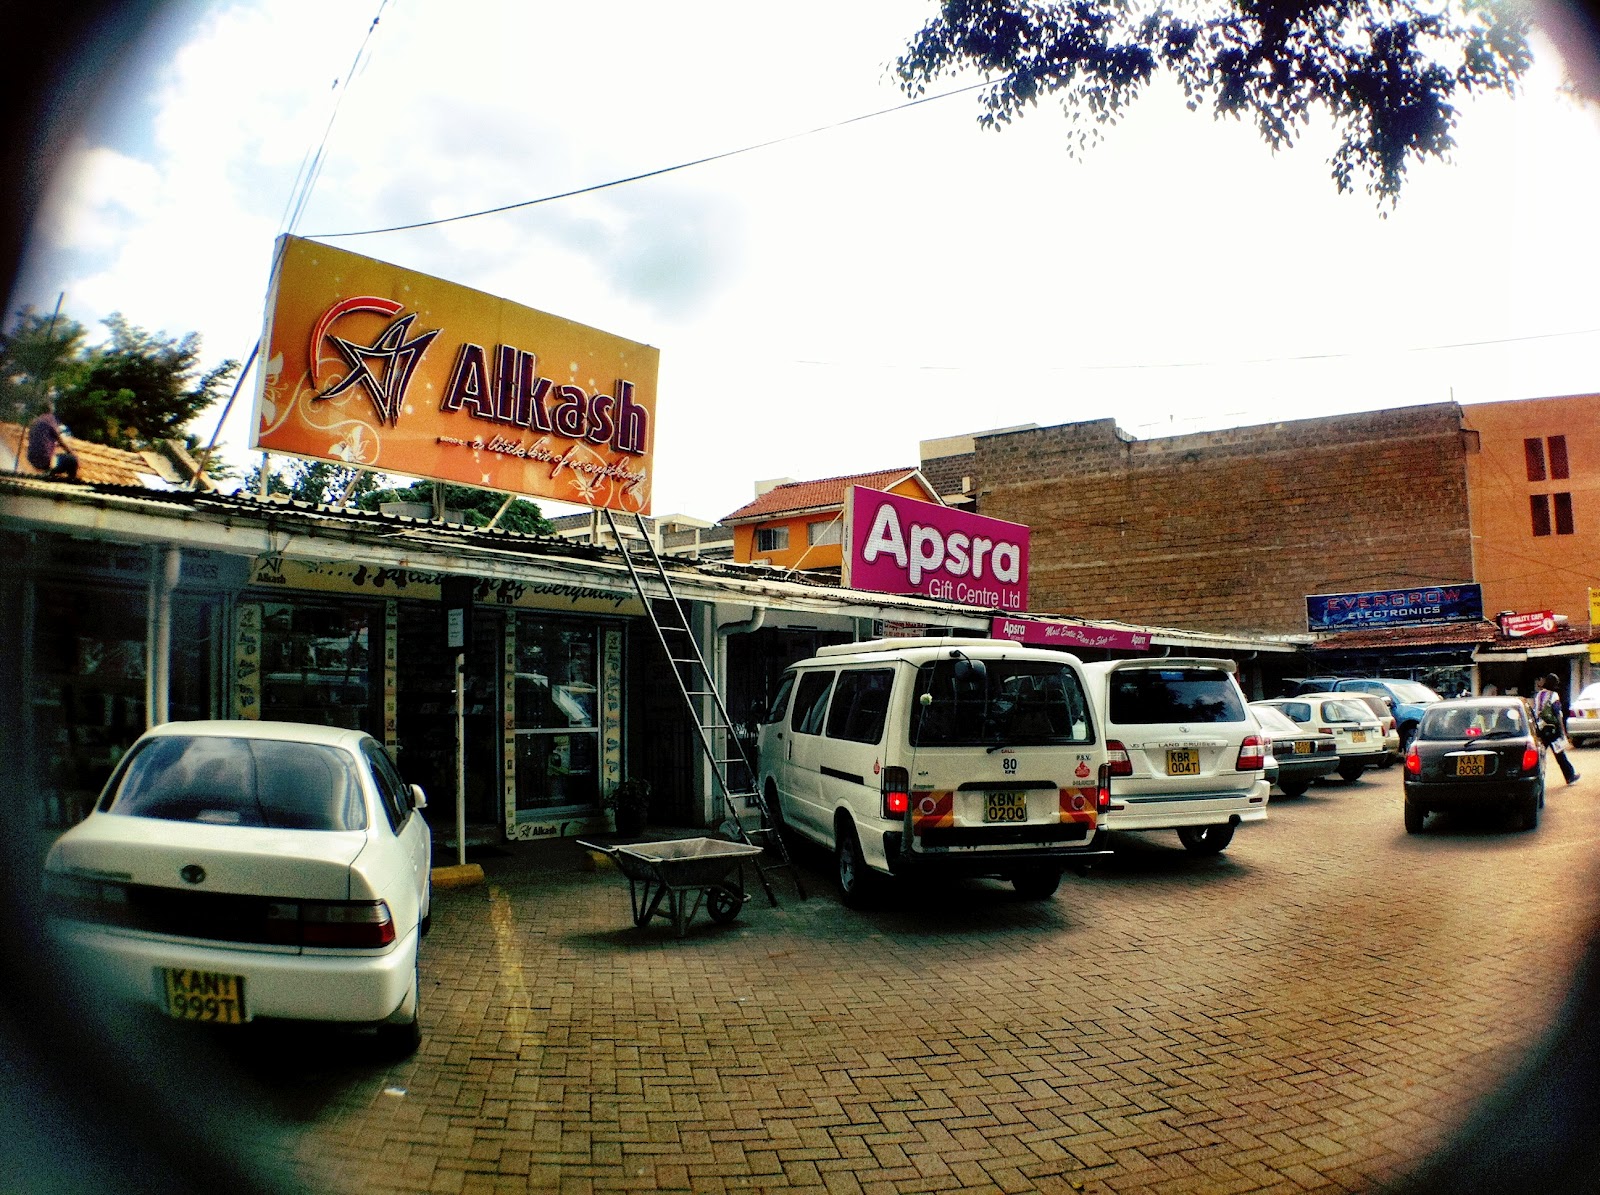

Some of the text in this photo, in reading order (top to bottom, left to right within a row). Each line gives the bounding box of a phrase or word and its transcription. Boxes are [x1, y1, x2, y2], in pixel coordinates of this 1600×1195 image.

[440, 343, 650, 456] Alkash
[487, 434, 525, 457] little
[525, 436, 551, 462] bit
[863, 503, 1020, 585] Apsra
[929, 578, 1020, 608] Gift Centre Ltd
[1327, 589, 1461, 611] EVERGROW
[1348, 606, 1441, 620] ELECTRONICS
[1003, 620, 1026, 637] Apsra
[1003, 758, 1017, 770] 80
[1171, 752, 1190, 763] KBR
[1460, 755, 1479, 765] KAX
[1171, 762, 1197, 773] 004T
[988, 793, 1015, 807] KBN
[988, 806, 1024, 820] 020Q
